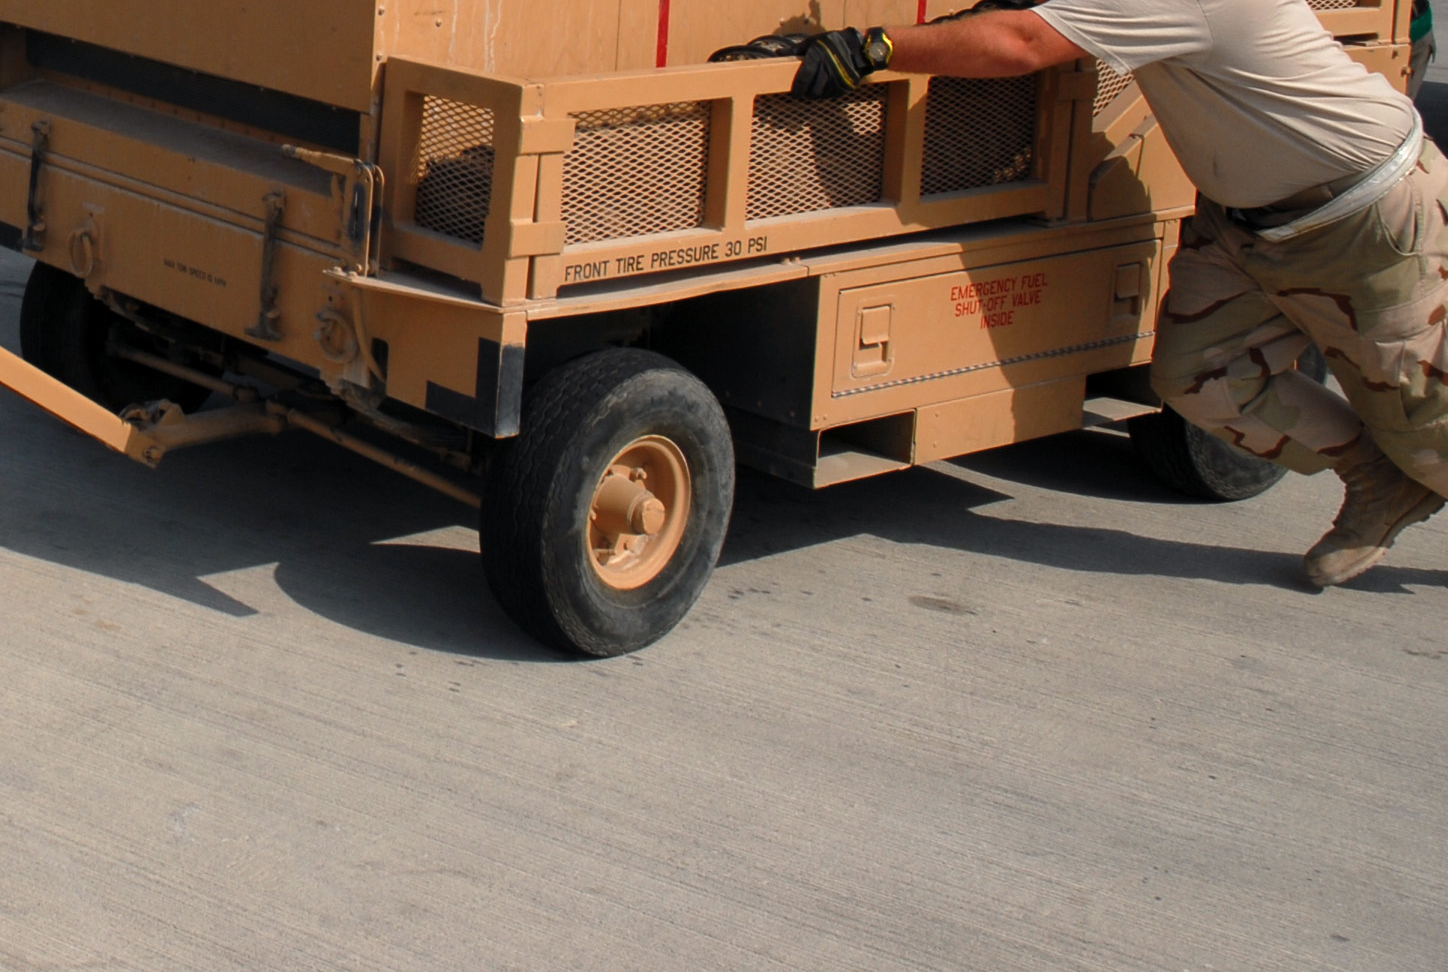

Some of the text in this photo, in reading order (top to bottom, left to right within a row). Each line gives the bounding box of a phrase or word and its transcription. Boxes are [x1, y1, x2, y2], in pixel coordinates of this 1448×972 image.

[564, 236, 768, 282] FRONT TIRE PRESSURE 30 PSI
[950, 272, 1048, 301] EMERGENCY FUEL
[954, 289, 1042, 317] SHUT-OFF VALVE
[980, 310, 1015, 330] INSIDE
